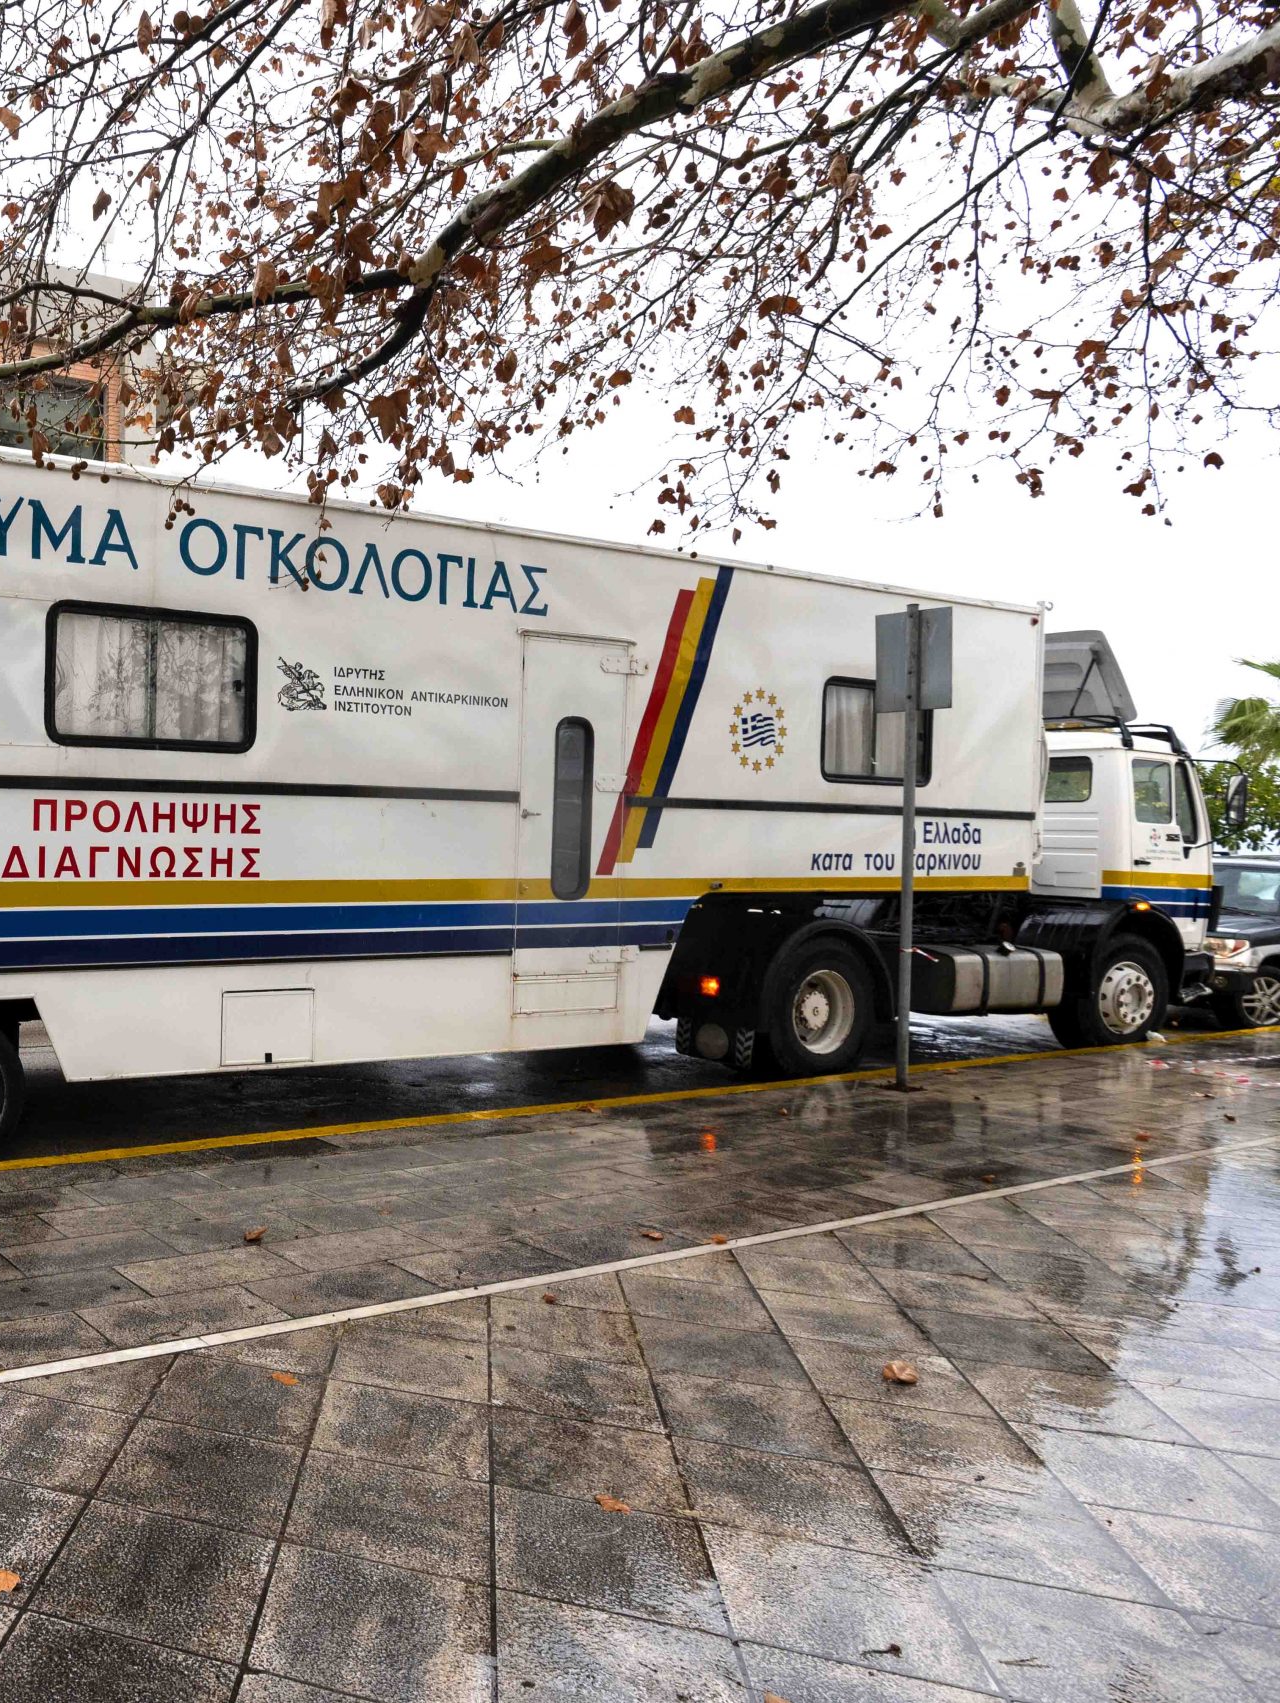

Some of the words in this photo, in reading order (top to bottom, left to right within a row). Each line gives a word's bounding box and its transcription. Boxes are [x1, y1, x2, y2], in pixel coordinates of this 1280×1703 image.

[179, 518, 549, 617] ΟΓΚΟΛΟΓΙΑΣ
[334, 666, 386, 681] ΙΔΡΥΤΗΣ
[334, 684, 404, 701] ΕΛΛΗΝΙΚΟΝ
[410, 690, 509, 708] ΑΝΤΙΚΑΡΚΙΝΙΚΟΝ
[334, 700, 413, 717] ΙΝΣΤΙΤΟΥΤΟΝ
[32, 799, 261, 835] ΠΡΟΛΗΨΗΣ
[923, 821, 982, 844] Ελλαδα
[1, 845, 261, 879] ΔΙΑΓΝΩΣΗΣ
[810, 853, 853, 871] κατα
[864, 853, 895, 871] του
[913, 853, 982, 876] αρκινου
